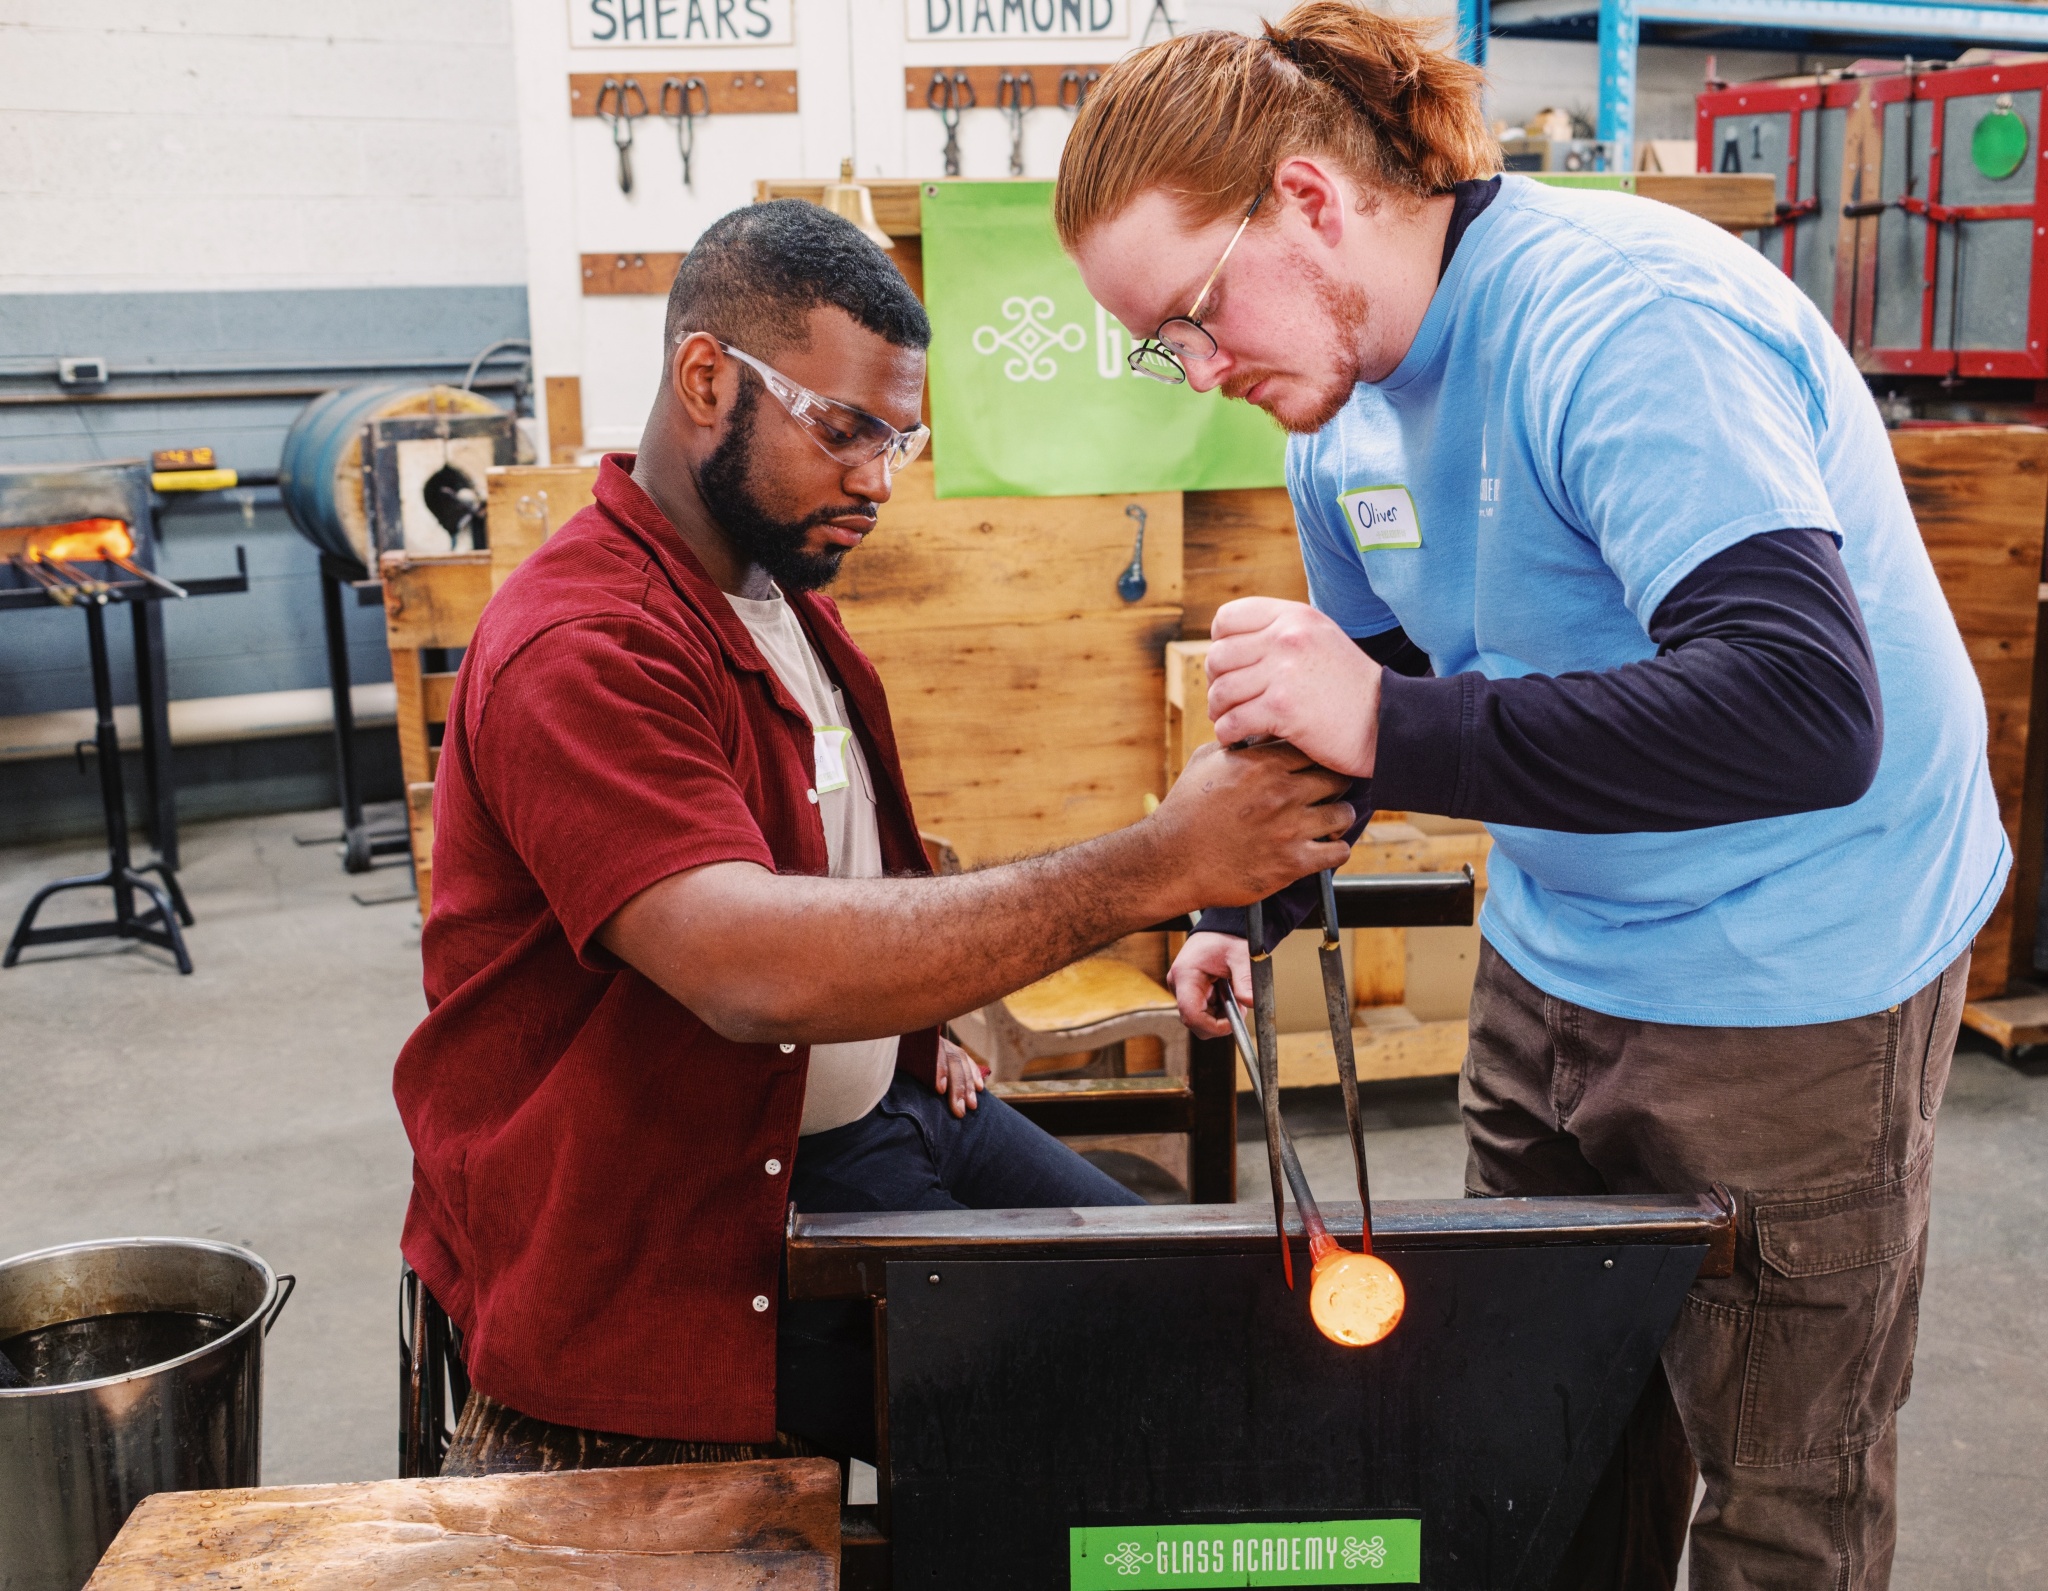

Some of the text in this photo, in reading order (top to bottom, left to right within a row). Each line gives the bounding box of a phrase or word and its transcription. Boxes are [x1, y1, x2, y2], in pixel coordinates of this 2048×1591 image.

[591, 0, 772, 40] SHEARS
[927, 0, 1113, 34] DIAMOND
[1358, 501, 1398, 528] Oliver
[1157, 1537, 1337, 1575] GLASS ACADEMY
